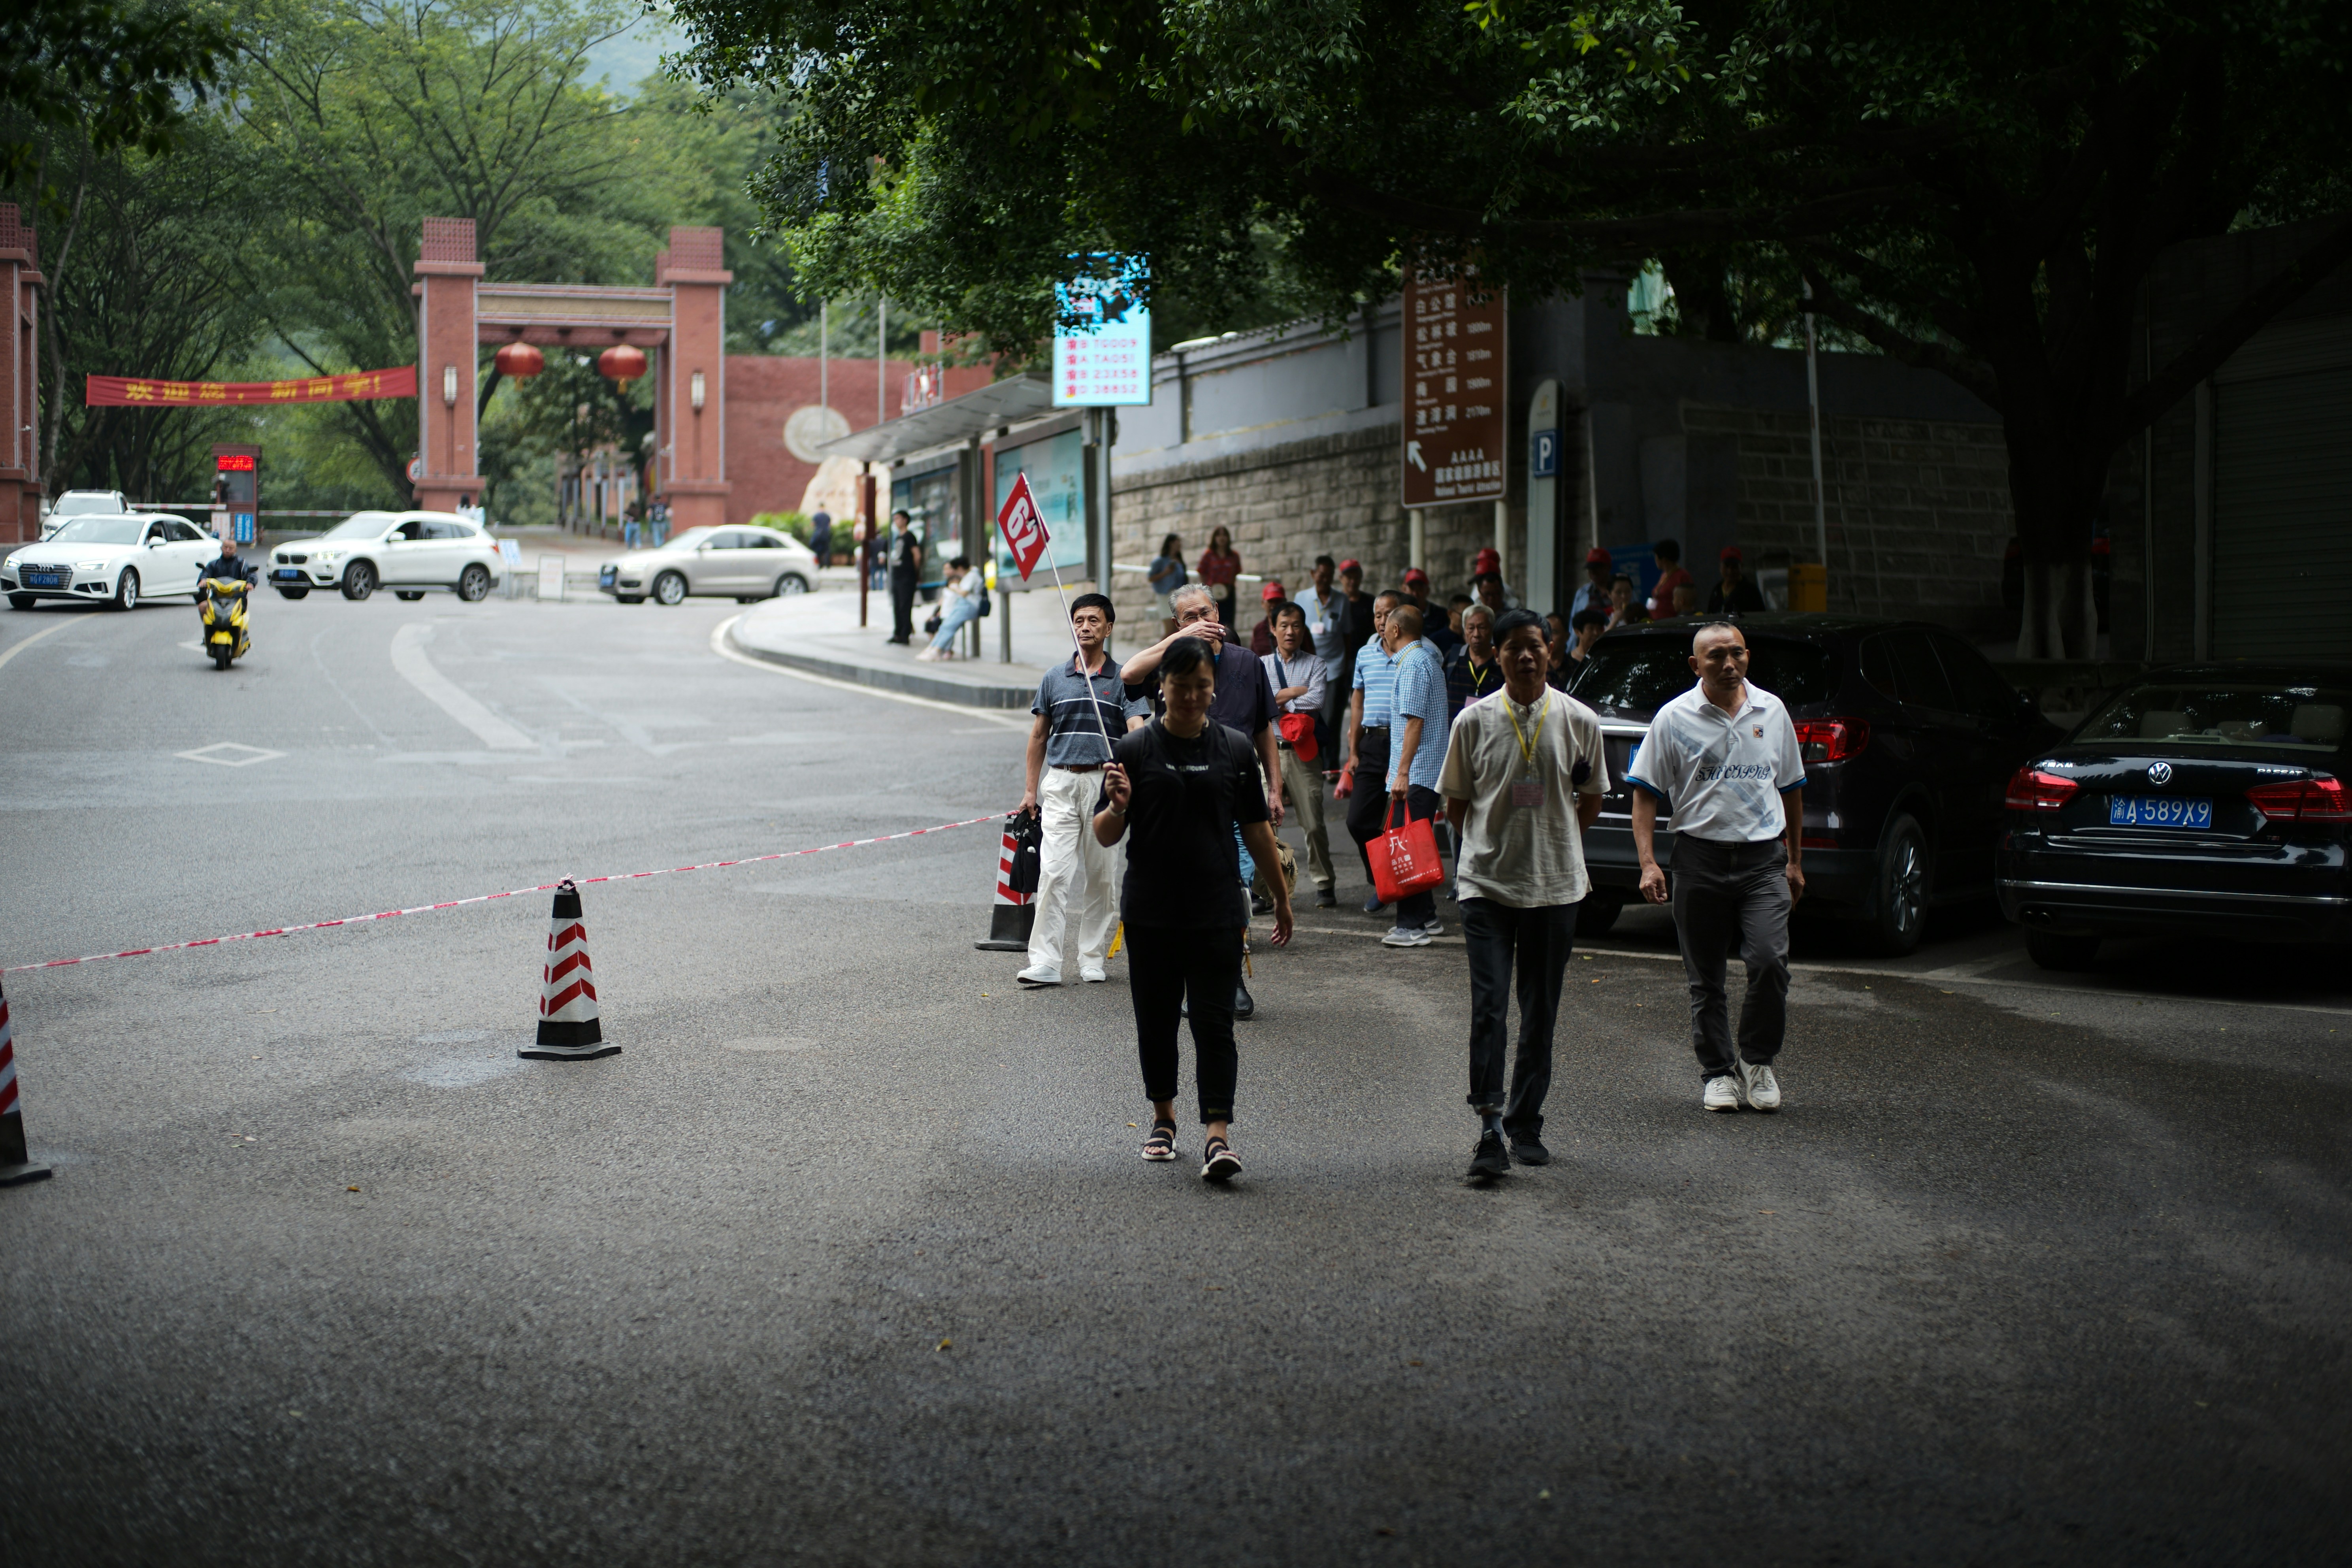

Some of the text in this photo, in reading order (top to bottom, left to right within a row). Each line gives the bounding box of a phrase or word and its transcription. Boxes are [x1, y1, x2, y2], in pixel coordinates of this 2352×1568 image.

[1415, 292, 1456, 314] 白公馆
[1539, 436, 1552, 471] P
